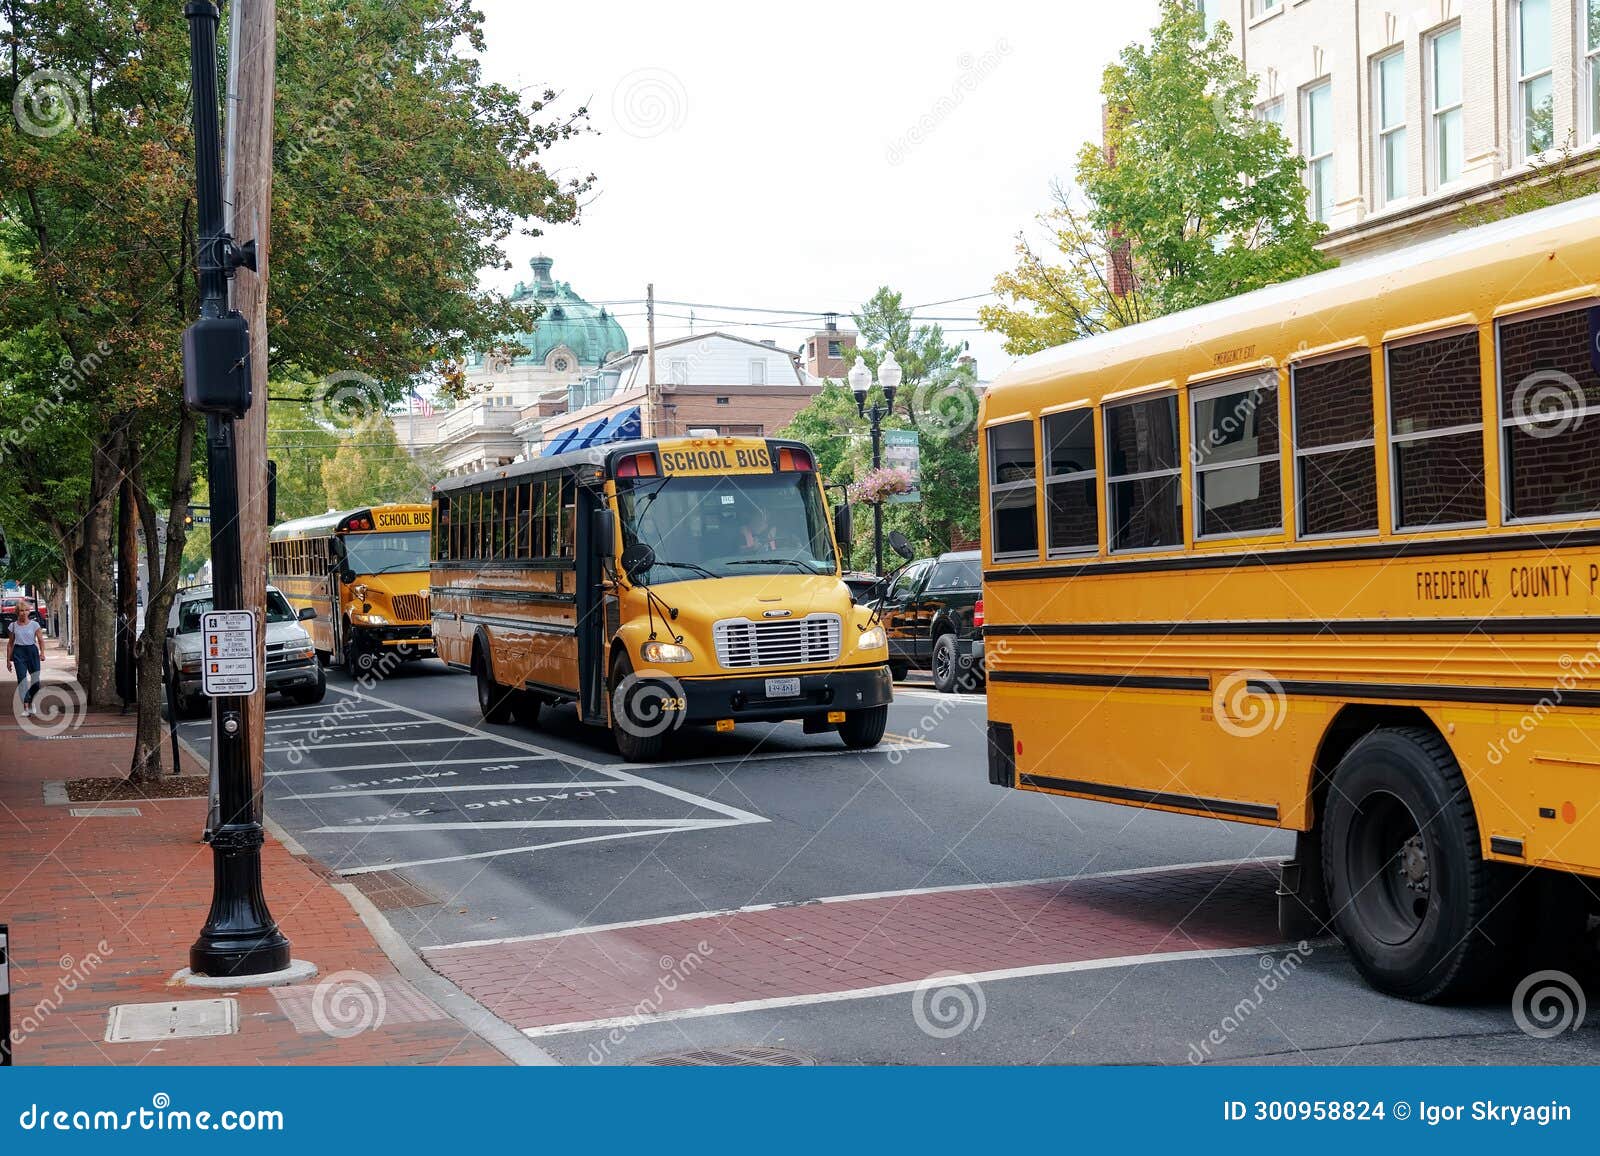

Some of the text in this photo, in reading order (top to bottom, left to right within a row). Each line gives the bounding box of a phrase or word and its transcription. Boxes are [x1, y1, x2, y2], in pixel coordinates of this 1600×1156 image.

[662, 448, 770, 471] SCHOOL BUS
[379, 512, 430, 527] SCHOOL BUS
[1416, 569, 1491, 600] FREDERICK
[1510, 564, 1572, 598] COUNTY
[660, 697, 686, 711] 229
[464, 788, 618, 810] LOADING
